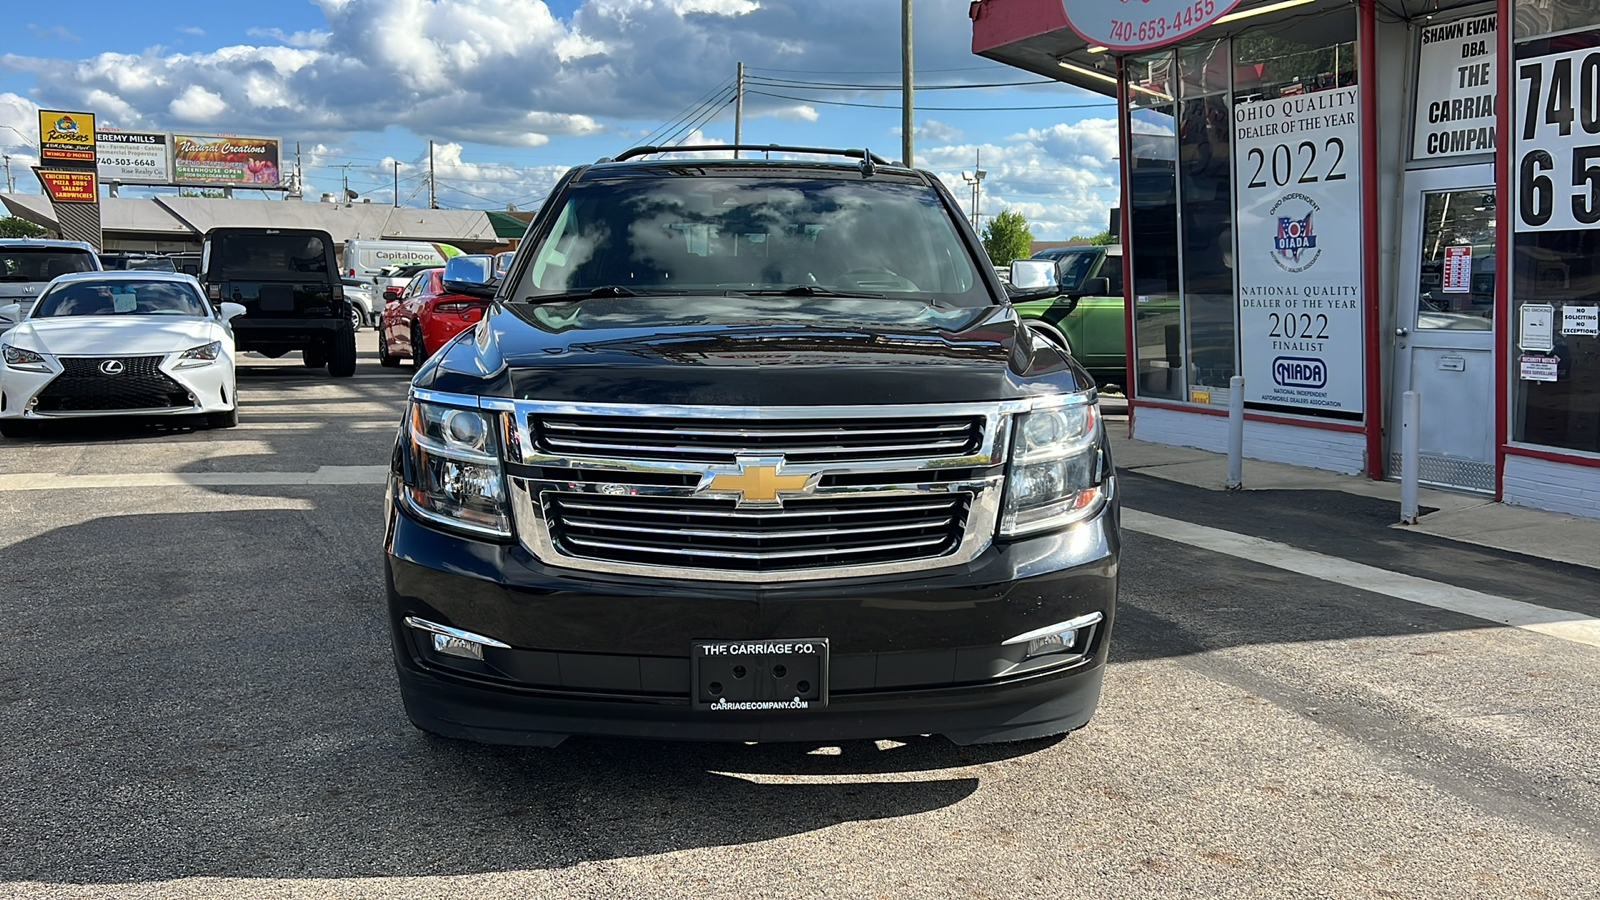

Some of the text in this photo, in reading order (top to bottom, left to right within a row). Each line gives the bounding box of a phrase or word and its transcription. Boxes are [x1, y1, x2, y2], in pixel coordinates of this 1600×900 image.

[1109, 0, 1214, 42] 740-653-4455
[1423, 17, 1497, 45] SHAWN EVAN
[1462, 40, 1488, 58] DBA.
[1458, 63, 1490, 88] THE
[1519, 52, 1600, 141] 740
[1236, 90, 1357, 122] OHIO QUALITY
[1428, 94, 1497, 124] CARRIA
[1238, 111, 1355, 140] DEALER OF THE YEAR
[46, 129, 89, 142] Roosters
[96, 133, 155, 143] EREMY MILLS
[1427, 126, 1497, 154] COMPAN
[180, 141, 266, 154] Natural Creations
[96, 157, 156, 167] 740-503-6648
[1247, 137, 1346, 189] 2022
[1270, 193, 1321, 215] OHIO INDEPENDENT
[1279, 236, 1309, 249] OIADA
[376, 251, 434, 260] CapitalDoor
[1241, 286, 1358, 297] NATIONAL QUALITY
[1243, 299, 1356, 309] DEALER OF THE YEAR
[1268, 312, 1329, 339] 2022
[1272, 341, 1324, 352] FINALIST
[1276, 362, 1322, 384] NIADA
[1273, 388, 1328, 398] NATIONAL INDEPENDENT
[703, 643, 816, 655] THE CARRIAGE CO.
[710, 701, 808, 710] CARRIAGECOMPANY.COM
